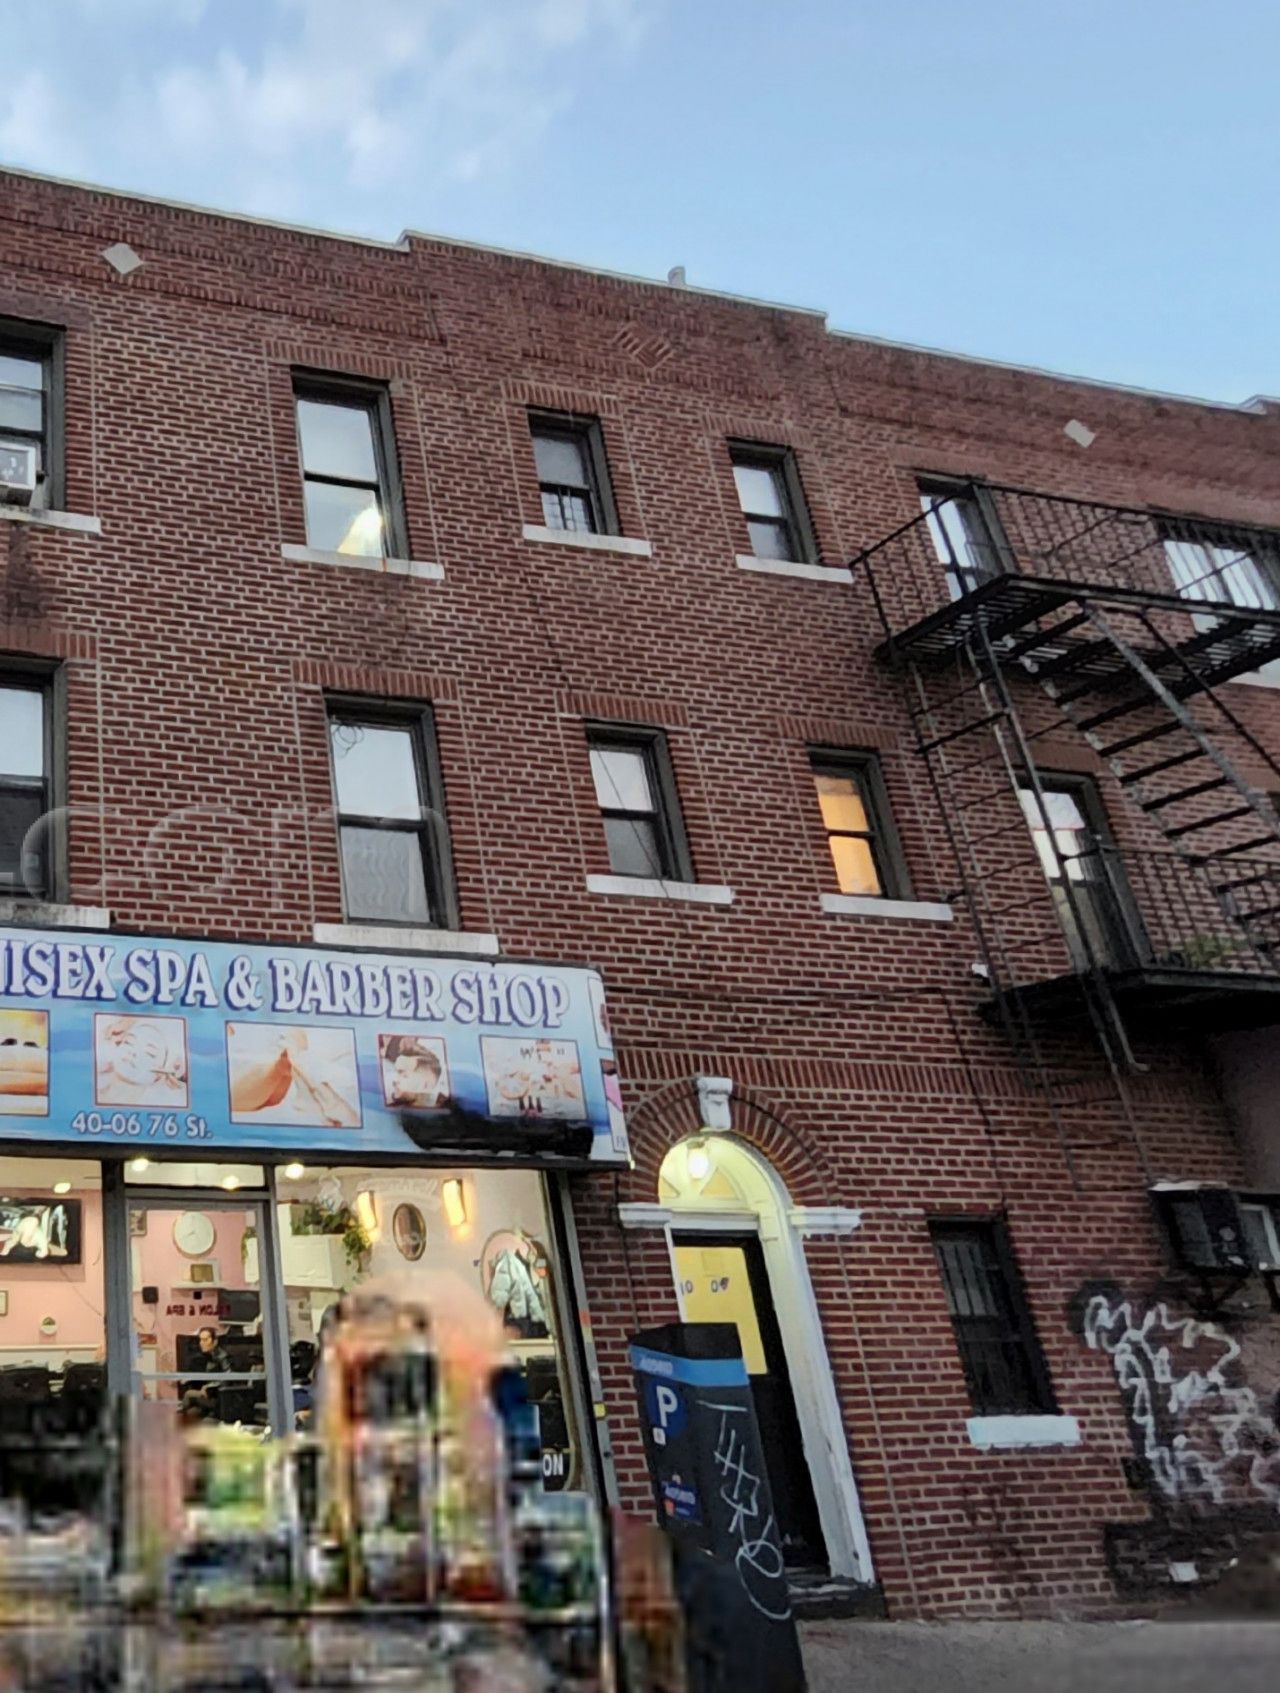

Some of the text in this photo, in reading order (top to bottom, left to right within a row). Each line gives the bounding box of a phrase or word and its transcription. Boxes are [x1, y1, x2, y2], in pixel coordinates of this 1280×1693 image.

[124, 947, 220, 1009] SPA
[225, 955, 264, 1012] &
[269, 957, 446, 1021] BARBER
[451, 968, 570, 1029] SHOP
[72, 1111, 141, 1136] 40-06
[148, 1114, 179, 1137] 76
[656, 1385, 678, 1428] P
